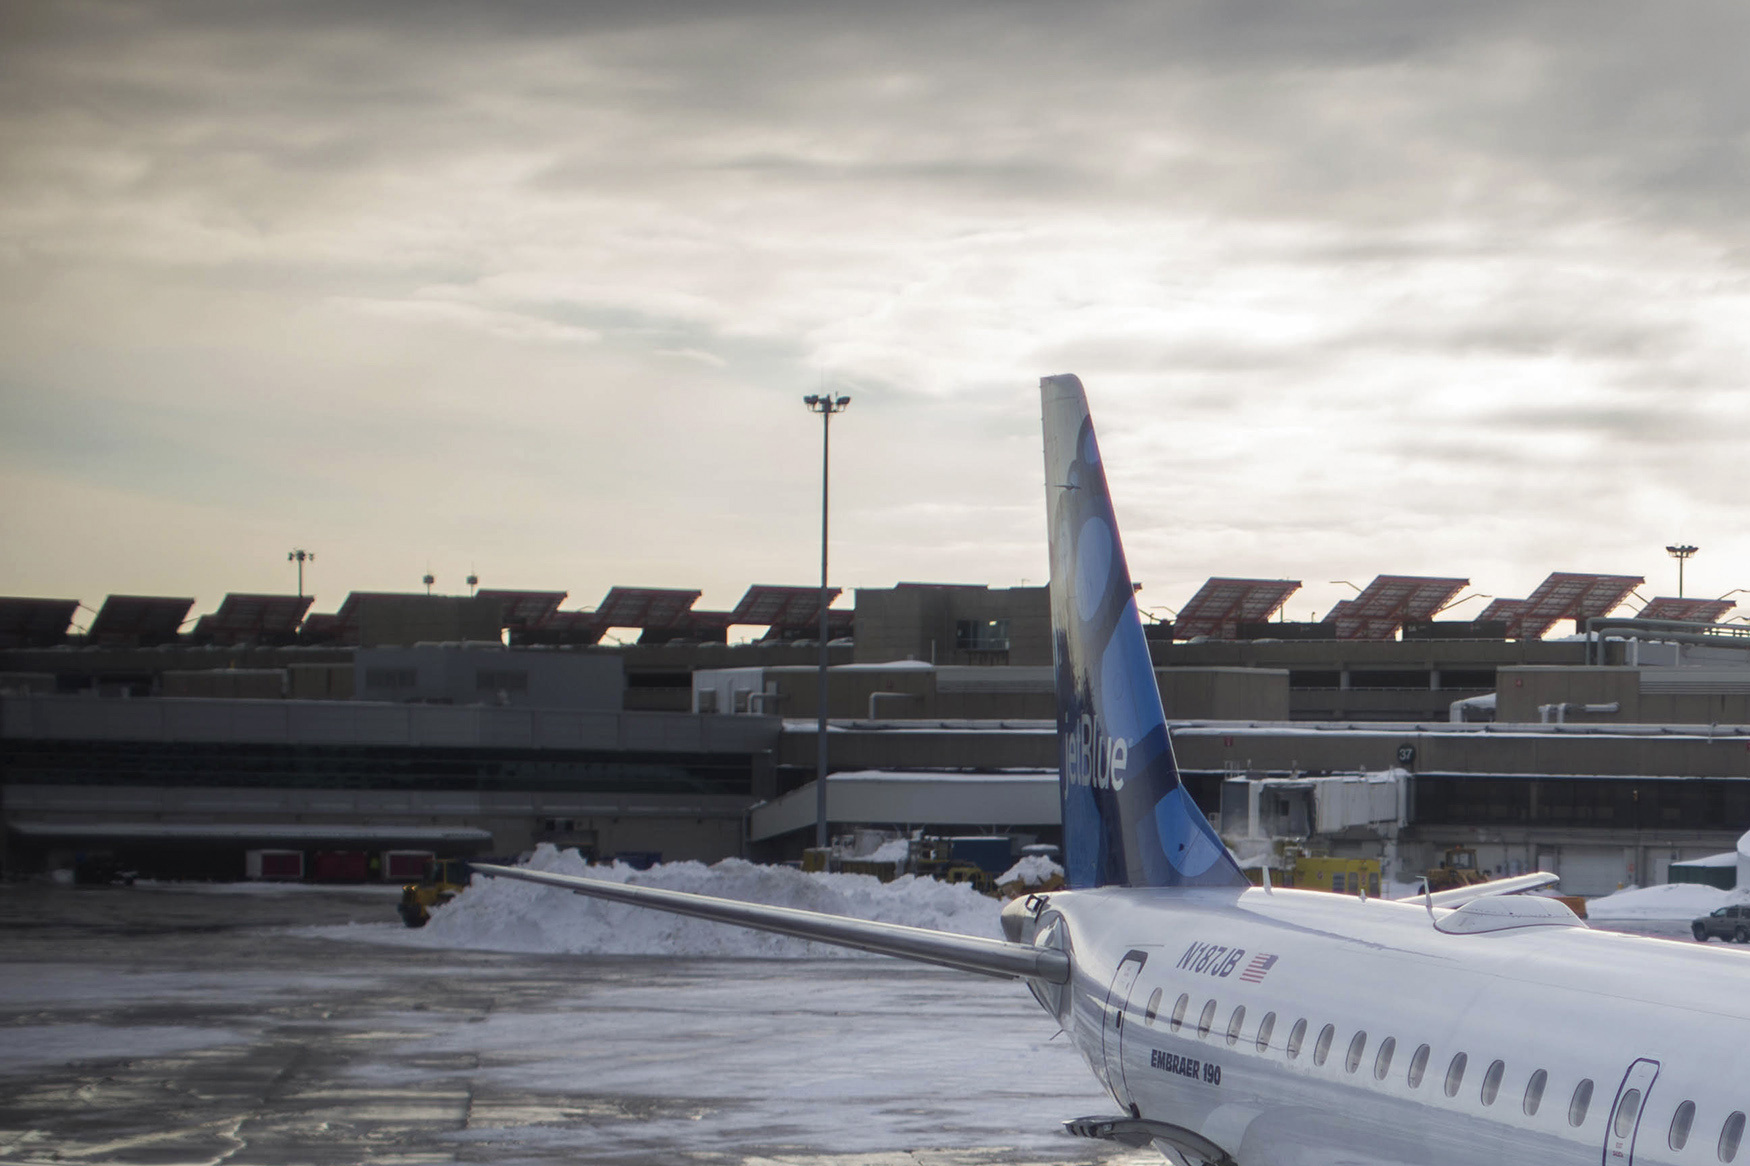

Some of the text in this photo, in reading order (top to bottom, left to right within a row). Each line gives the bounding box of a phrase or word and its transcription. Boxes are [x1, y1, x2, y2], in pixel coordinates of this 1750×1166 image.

[1064, 711, 1128, 801] jetBlue
[1398, 747, 1413, 762] 37
[1175, 941, 1246, 978] N187JB
[1150, 1048, 1222, 1086] EMBRAER 190
